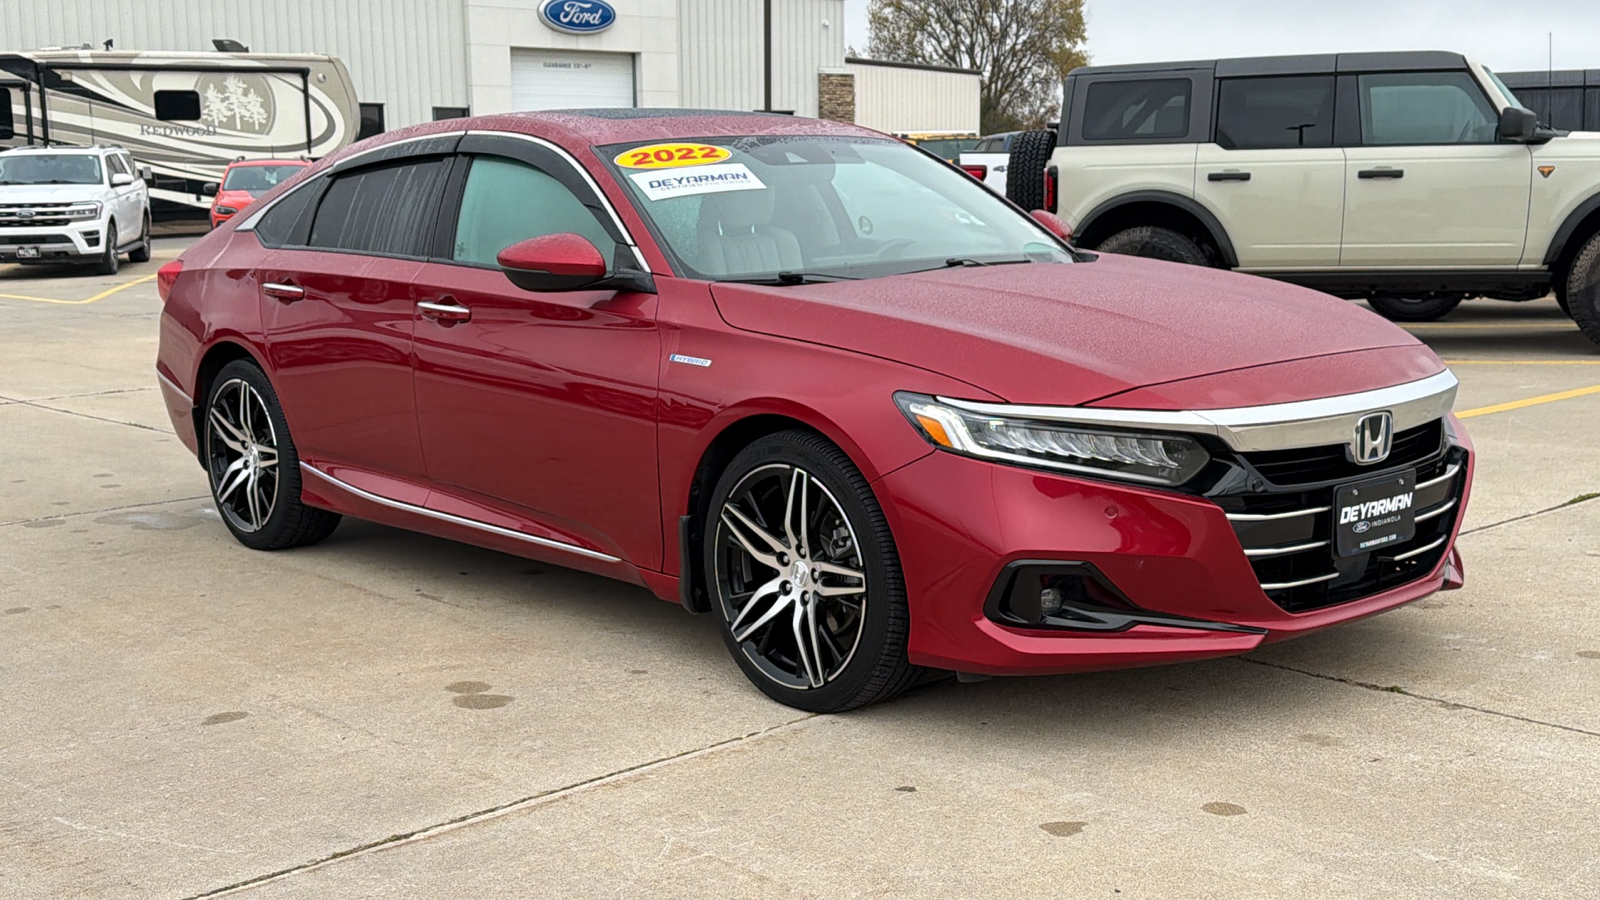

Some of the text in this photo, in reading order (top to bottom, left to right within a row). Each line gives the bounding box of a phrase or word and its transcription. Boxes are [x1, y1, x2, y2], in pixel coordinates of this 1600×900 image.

[560, 1, 602, 24] Ford
[139, 124, 217, 136] REDWOOD
[630, 146, 722, 166] 2022
[648, 172, 748, 189] DEYARMAN
[660, 183, 703, 192] CERTIFIED
[675, 356, 708, 365] HYBRID
[1340, 492, 1413, 524] DEYARMAN
[1372, 514, 1401, 528] INDIANOLA
